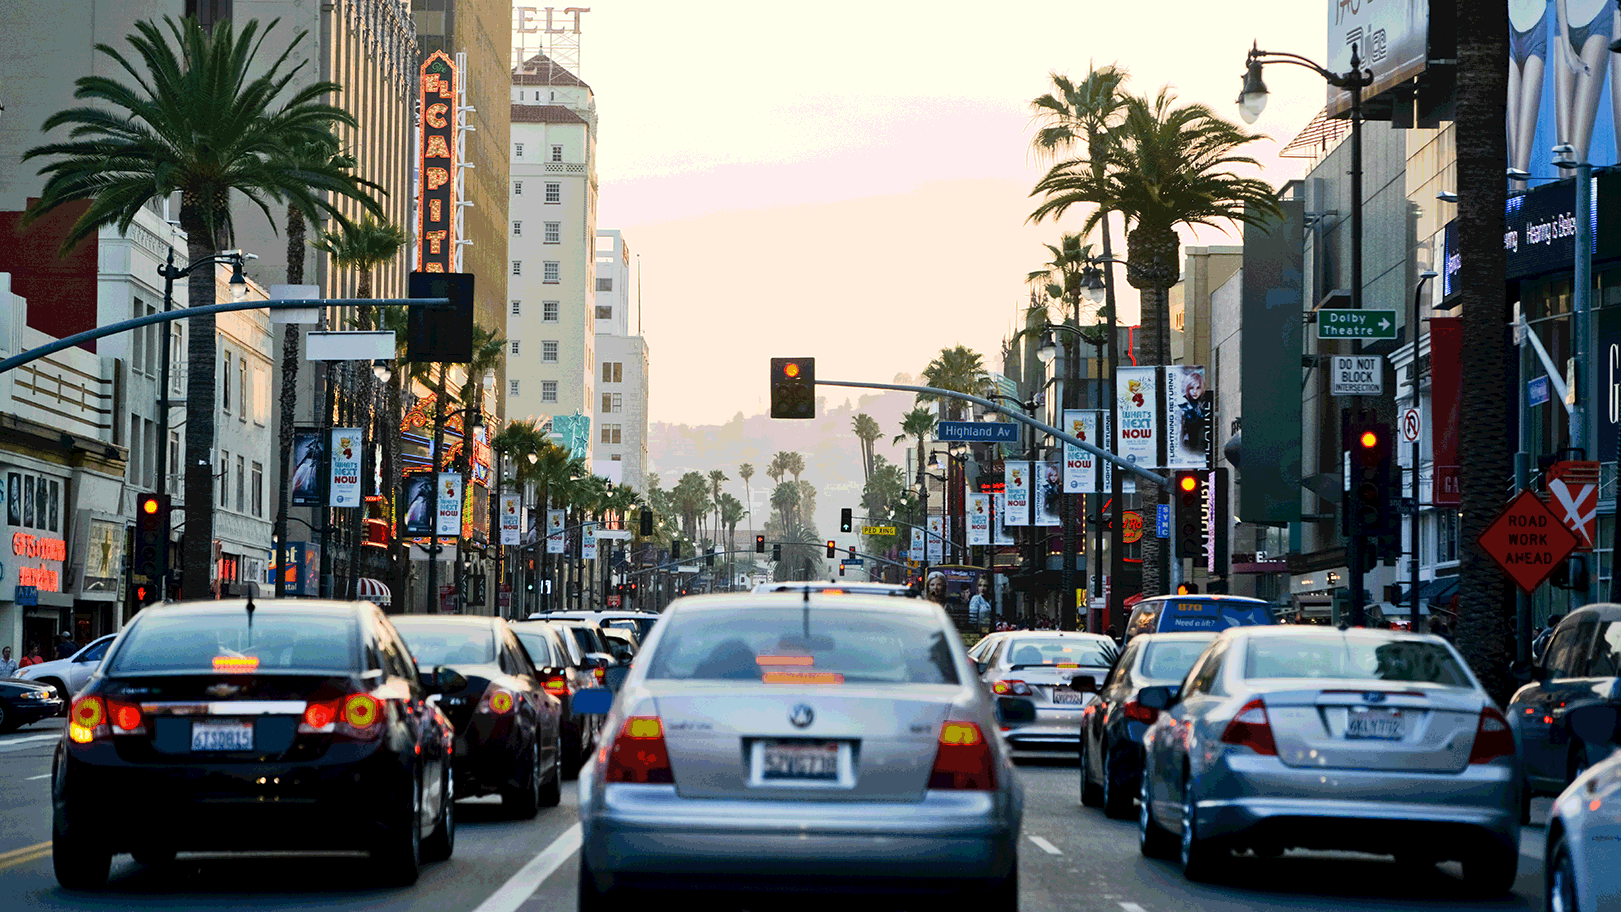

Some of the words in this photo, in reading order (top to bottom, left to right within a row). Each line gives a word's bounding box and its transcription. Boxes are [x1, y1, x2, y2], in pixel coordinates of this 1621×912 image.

[516, 7, 591, 34] ELT
[425, 74, 452, 98] EL
[1330, 313, 1366, 324] Dolby
[1323, 325, 1373, 335] Theatre
[1339, 358, 1352, 370] DO
[1357, 358, 1375, 370] NOT
[1341, 371, 1373, 382] BLOCK
[1335, 383, 1379, 391] INTERSECTION
[1122, 419, 1151, 428] NEXT
[946, 425, 992, 438] Highland
[997, 427, 1011, 437] Av
[1122, 429, 1152, 439] NOW
[1067, 452, 1091, 460] NEXT
[1067, 460, 1092, 468] NOW
[334, 468, 358, 476] NEXT
[334, 476, 358, 484] NOW
[1444, 476, 1460, 493] GA
[1508, 515, 1548, 527] ROAD
[880, 527, 894, 535] XING
[1508, 533, 1548, 546] WORK
[1505, 552, 1553, 565] AHEAD
[19, 587, 37, 596] ATM
